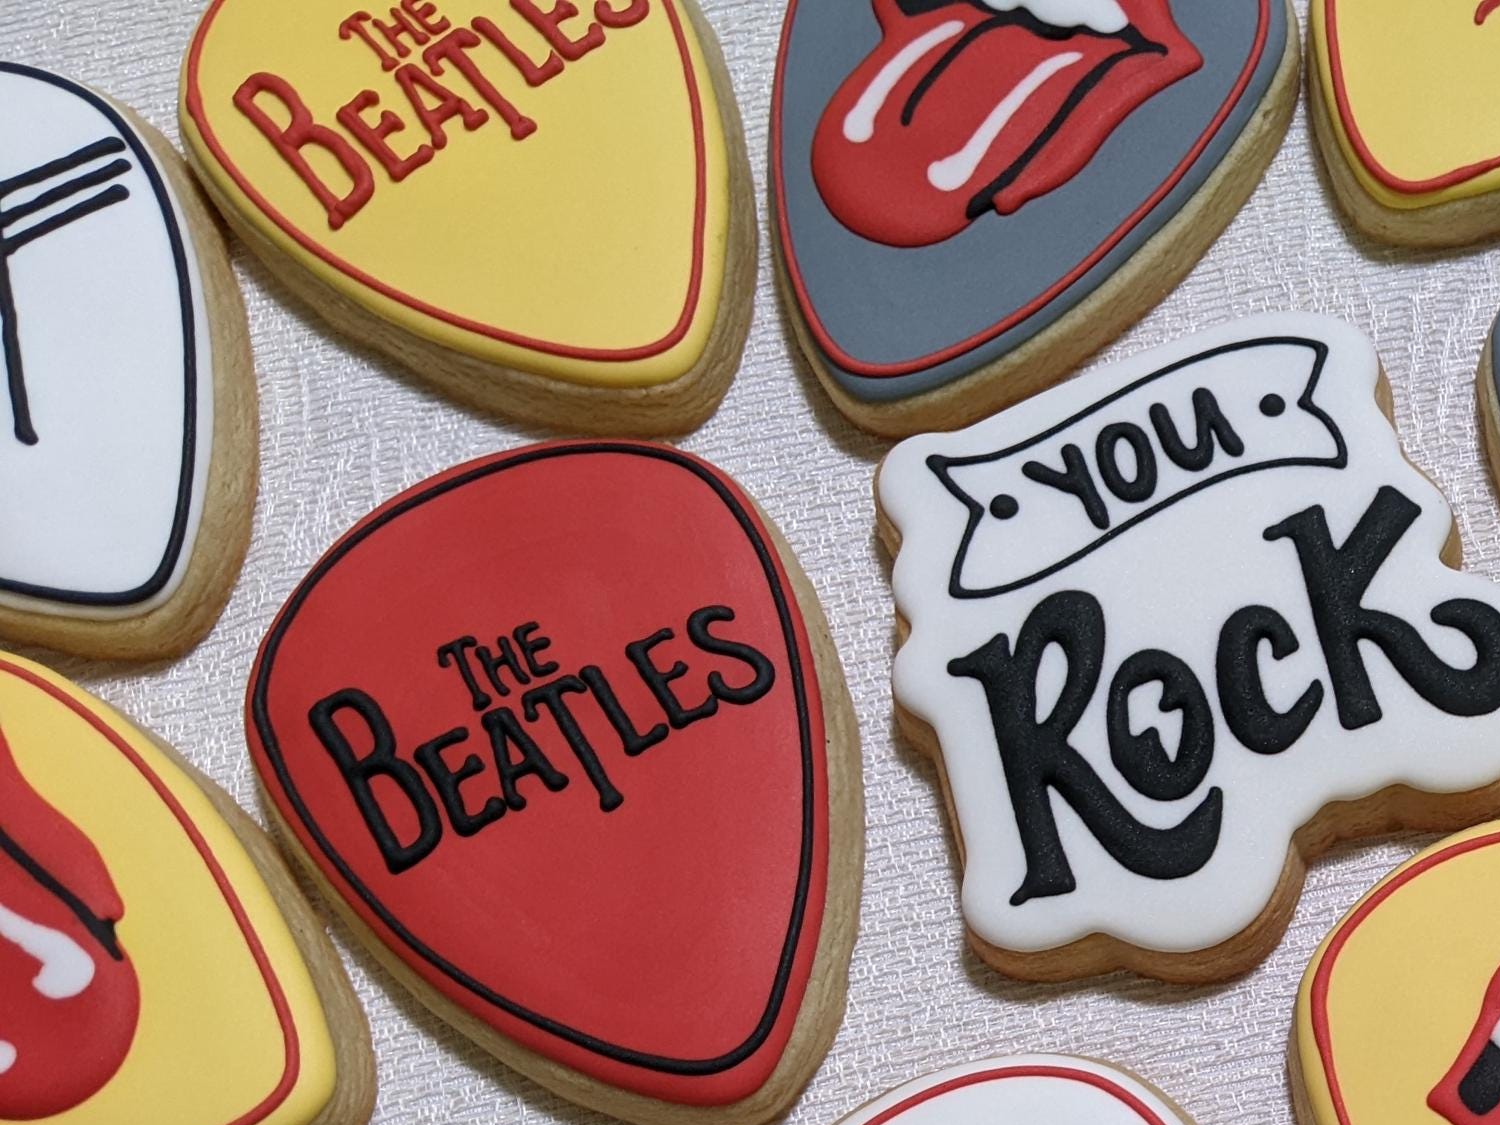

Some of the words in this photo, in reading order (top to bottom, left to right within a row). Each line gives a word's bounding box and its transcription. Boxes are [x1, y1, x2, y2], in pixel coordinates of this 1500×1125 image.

[1021, 387, 1245, 529] YOU
[437, 621, 559, 711] THE
[307, 605, 776, 874] BEATLES
